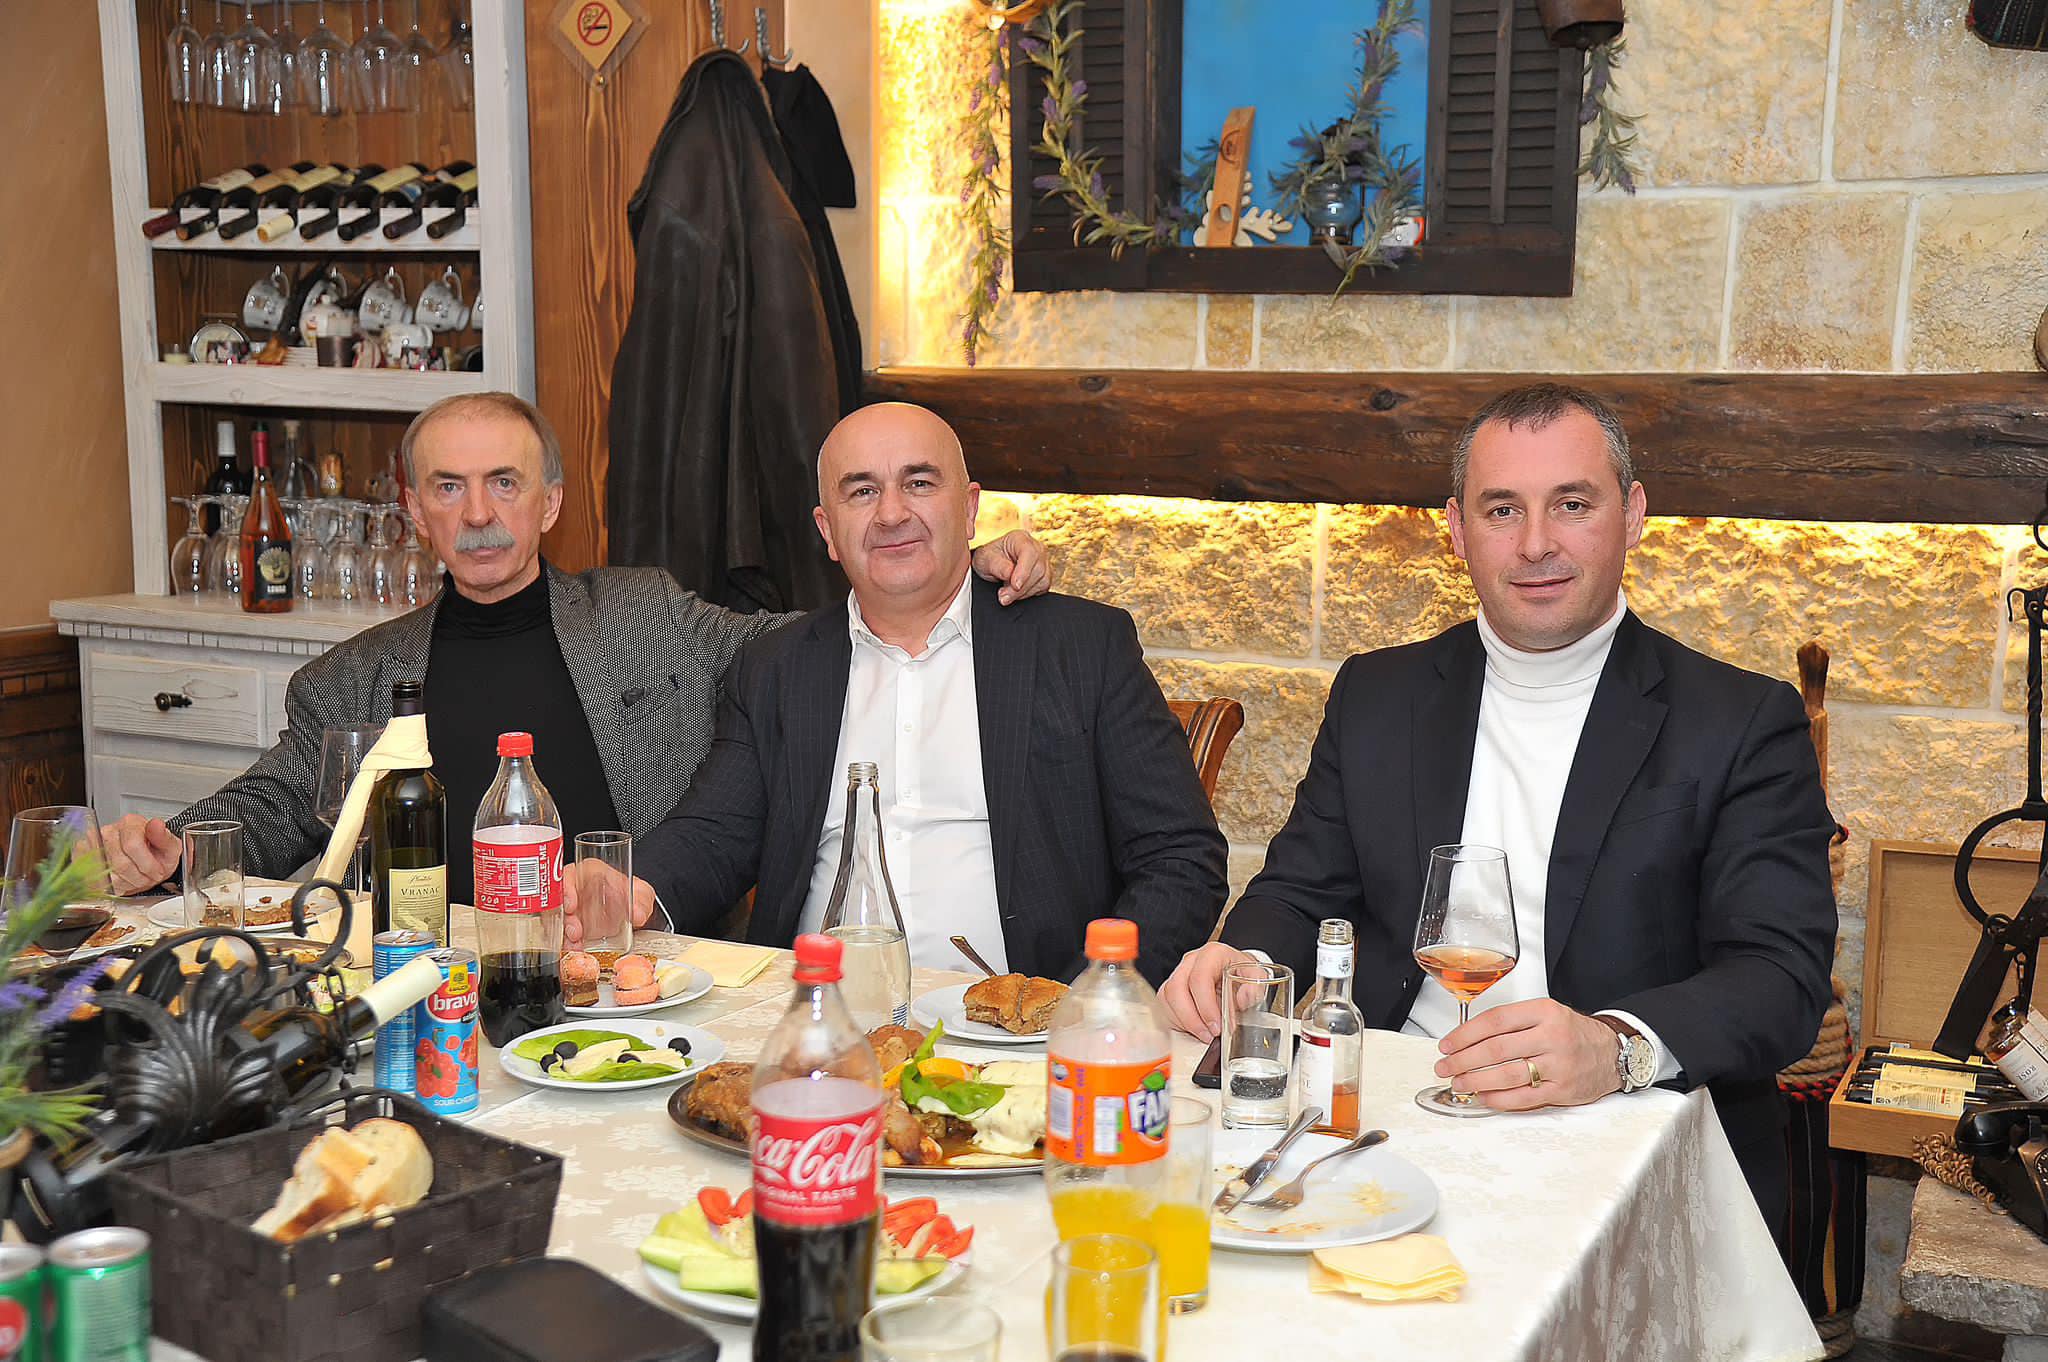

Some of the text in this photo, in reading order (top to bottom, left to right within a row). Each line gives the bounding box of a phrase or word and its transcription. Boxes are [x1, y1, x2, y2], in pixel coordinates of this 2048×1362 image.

[400, 887, 440, 896] VRANAC
[539, 843, 549, 908] RECYCLE ME
[433, 991, 477, 1011] bravo
[1128, 1083, 1169, 1132] FAN
